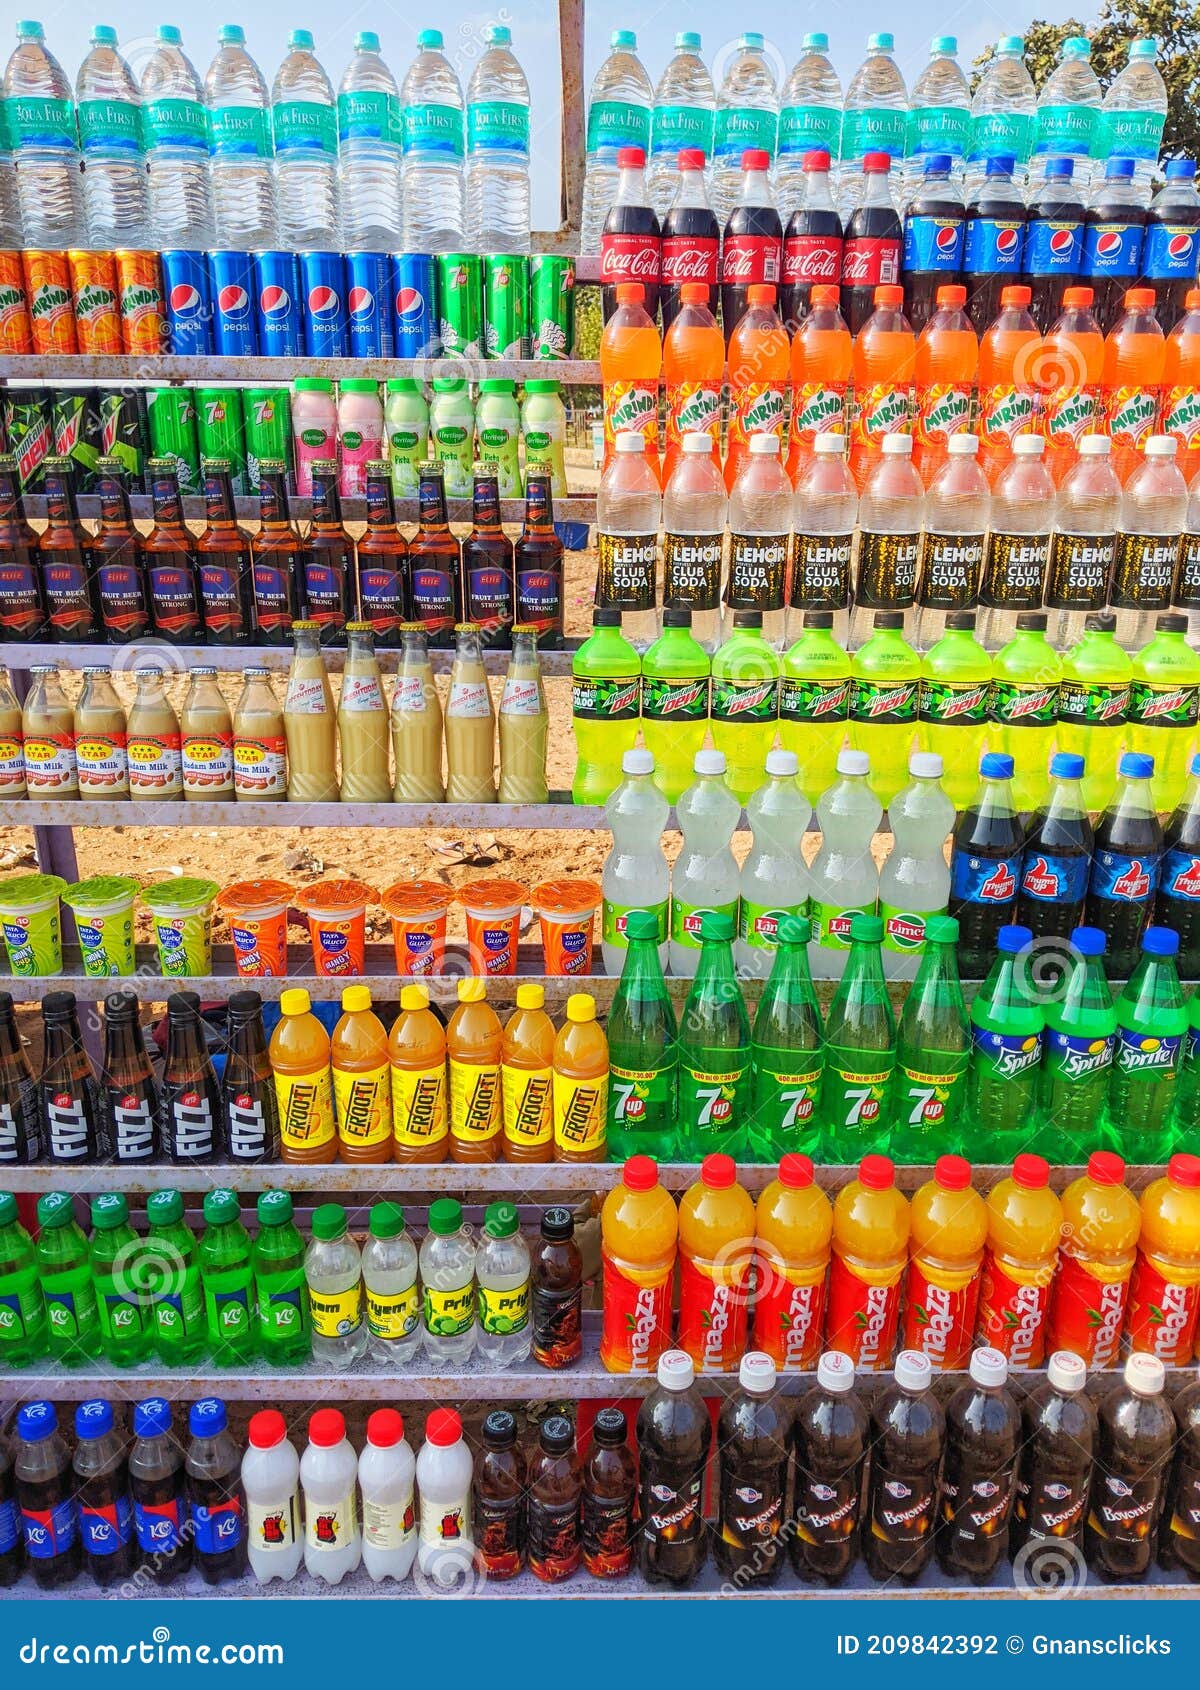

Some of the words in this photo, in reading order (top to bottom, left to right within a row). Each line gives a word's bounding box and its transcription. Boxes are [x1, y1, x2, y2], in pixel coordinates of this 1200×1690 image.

[106, 106, 136, 127] FIRST
[223, 112, 255, 130] FIRST
[290, 107, 321, 126] FIRST
[425, 109, 454, 129] FIRST
[678, 112, 705, 131] FIRST
[803, 112, 831, 131] FIRST
[941, 113, 967, 132] FIRST
[1066, 112, 1093, 130] FIRST
[602, 247, 659, 276] Coca-Cola
[1096, 258, 1119, 267] pepsi
[1168, 260, 1189, 269] pepsi
[31, 288, 71, 320] MIRINDA
[76, 288, 116, 318] MIRINDA
[121, 287, 161, 315] MIRINDA
[175, 321, 202, 332] pepsi
[223, 322, 250, 333] pepsi
[264, 322, 290, 333] pepsi
[312, 323, 338, 333] pepsi
[351, 324, 373, 334] pepsi
[399, 325, 422, 335] pepsi
[440, 452, 458, 460] Pista
[673, 566, 704, 578] CLUB
[735, 566, 766, 578] CLUB
[805, 566, 838, 578] CLUB
[932, 565, 965, 577] CLUB
[1008, 565, 1040, 577] CLUB
[1070, 566, 1102, 577] CLUB
[1141, 566, 1171, 577] CLUB
[368, 577, 389, 585] ELITE
[420, 577, 440, 586] ELITE
[480, 575, 501, 584] ELITE
[673, 577, 707, 588] SODA
[734, 577, 769, 588] SODA
[805, 576, 840, 588] SODA
[931, 575, 967, 587] SODA
[1007, 575, 1040, 587] SODA
[1068, 576, 1104, 587] SODA
[1139, 576, 1172, 587] SODA
[53, 597, 80, 605] STRONG
[161, 600, 188, 608] STRONG
[27, 751, 51, 759] STAR
[82, 750, 107, 758] STAR
[132, 751, 156, 759] STAR
[237, 755, 259, 763] STAR
[44, 761, 63, 770] Milk
[99, 761, 118, 770] Milk
[149, 762, 168, 770] Milk
[208, 760, 227, 769] Milk
[252, 765, 270, 773] Milk
[986, 880, 1013, 892] Thums
[1027, 876, 1055, 886] Thums
[1120, 879, 1148, 888] Thums
[1000, 1045, 1041, 1074] Sprite
[1067, 1046, 1112, 1074] Sprite
[1119, 1047, 1170, 1067] Sprite
[349, 1079, 376, 1137] FROOTI
[410, 1077, 437, 1136] FROOTI
[468, 1072, 496, 1131] FROOTI
[519, 1078, 548, 1136] FROOTI
[288, 1083, 314, 1140] FROOTI
[564, 1086, 598, 1142] FROOTI
[48, 1099, 88, 1158] FIZZ
[115, 1099, 153, 1159] FIZZ
[174, 1098, 212, 1157] FIZZ
[229, 1100, 266, 1157] FIZZ
[157, 1309, 177, 1326] KC
[223, 1309, 241, 1325] KC
[275, 1308, 295, 1325] KC
[631, 1288, 656, 1373] maaza
[703, 1285, 729, 1373] maaza
[783, 1287, 812, 1372] maaza
[857, 1286, 888, 1373] maaza
[922, 1284, 954, 1374] maaza
[1008, 1287, 1039, 1371] maaza
[1091, 1283, 1122, 1371] maaza
[1154, 1284, 1187, 1368] maaza
[651, 1498, 699, 1529] Bovonto
[736, 1498, 782, 1531] Bovonto
[809, 1498, 857, 1528] Bovonto
[883, 1496, 931, 1525] Bovonto
[1102, 1500, 1155, 1521] Bovonto
[90, 1524, 110, 1540] KC
[150, 1521, 171, 1538] KC
[217, 1516, 237, 1537] KC
[27, 1528, 47, 1543] KC
